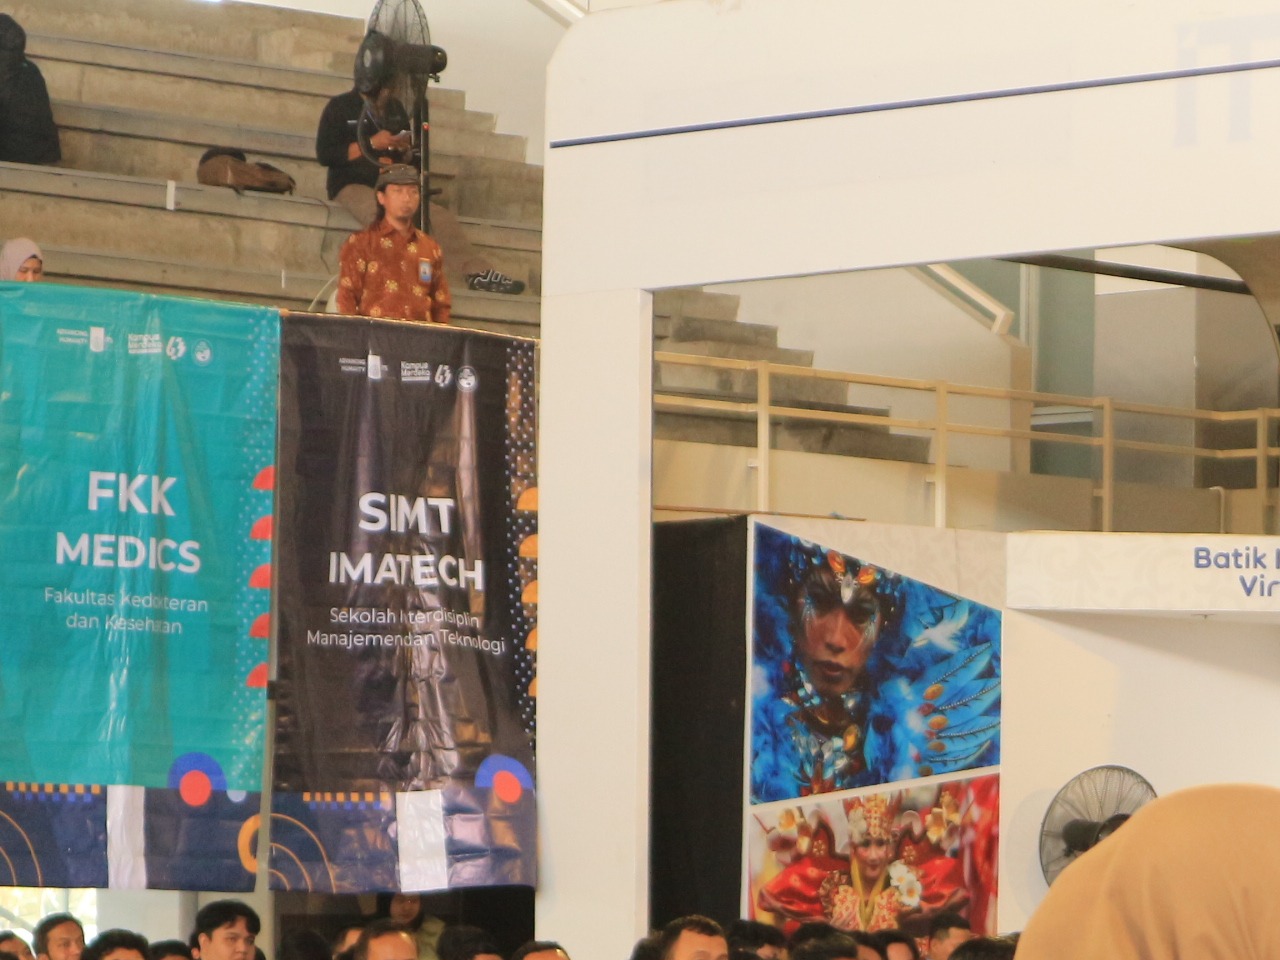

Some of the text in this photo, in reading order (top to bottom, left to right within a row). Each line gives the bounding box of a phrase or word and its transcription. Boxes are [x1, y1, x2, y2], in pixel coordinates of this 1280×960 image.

[88, 470, 177, 516] FKK
[358, 492, 454, 533] SIMT
[56, 531, 201, 573] MEDICS
[1193, 546, 1267, 570] Batik
[328, 551, 483, 590] IMATECH
[44, 587, 115, 606] Fakultas
[66, 613, 99, 629] dan
[330, 607, 479, 628] Sekolah Iterdisiplin
[440, 629, 506, 654] Teknologi
